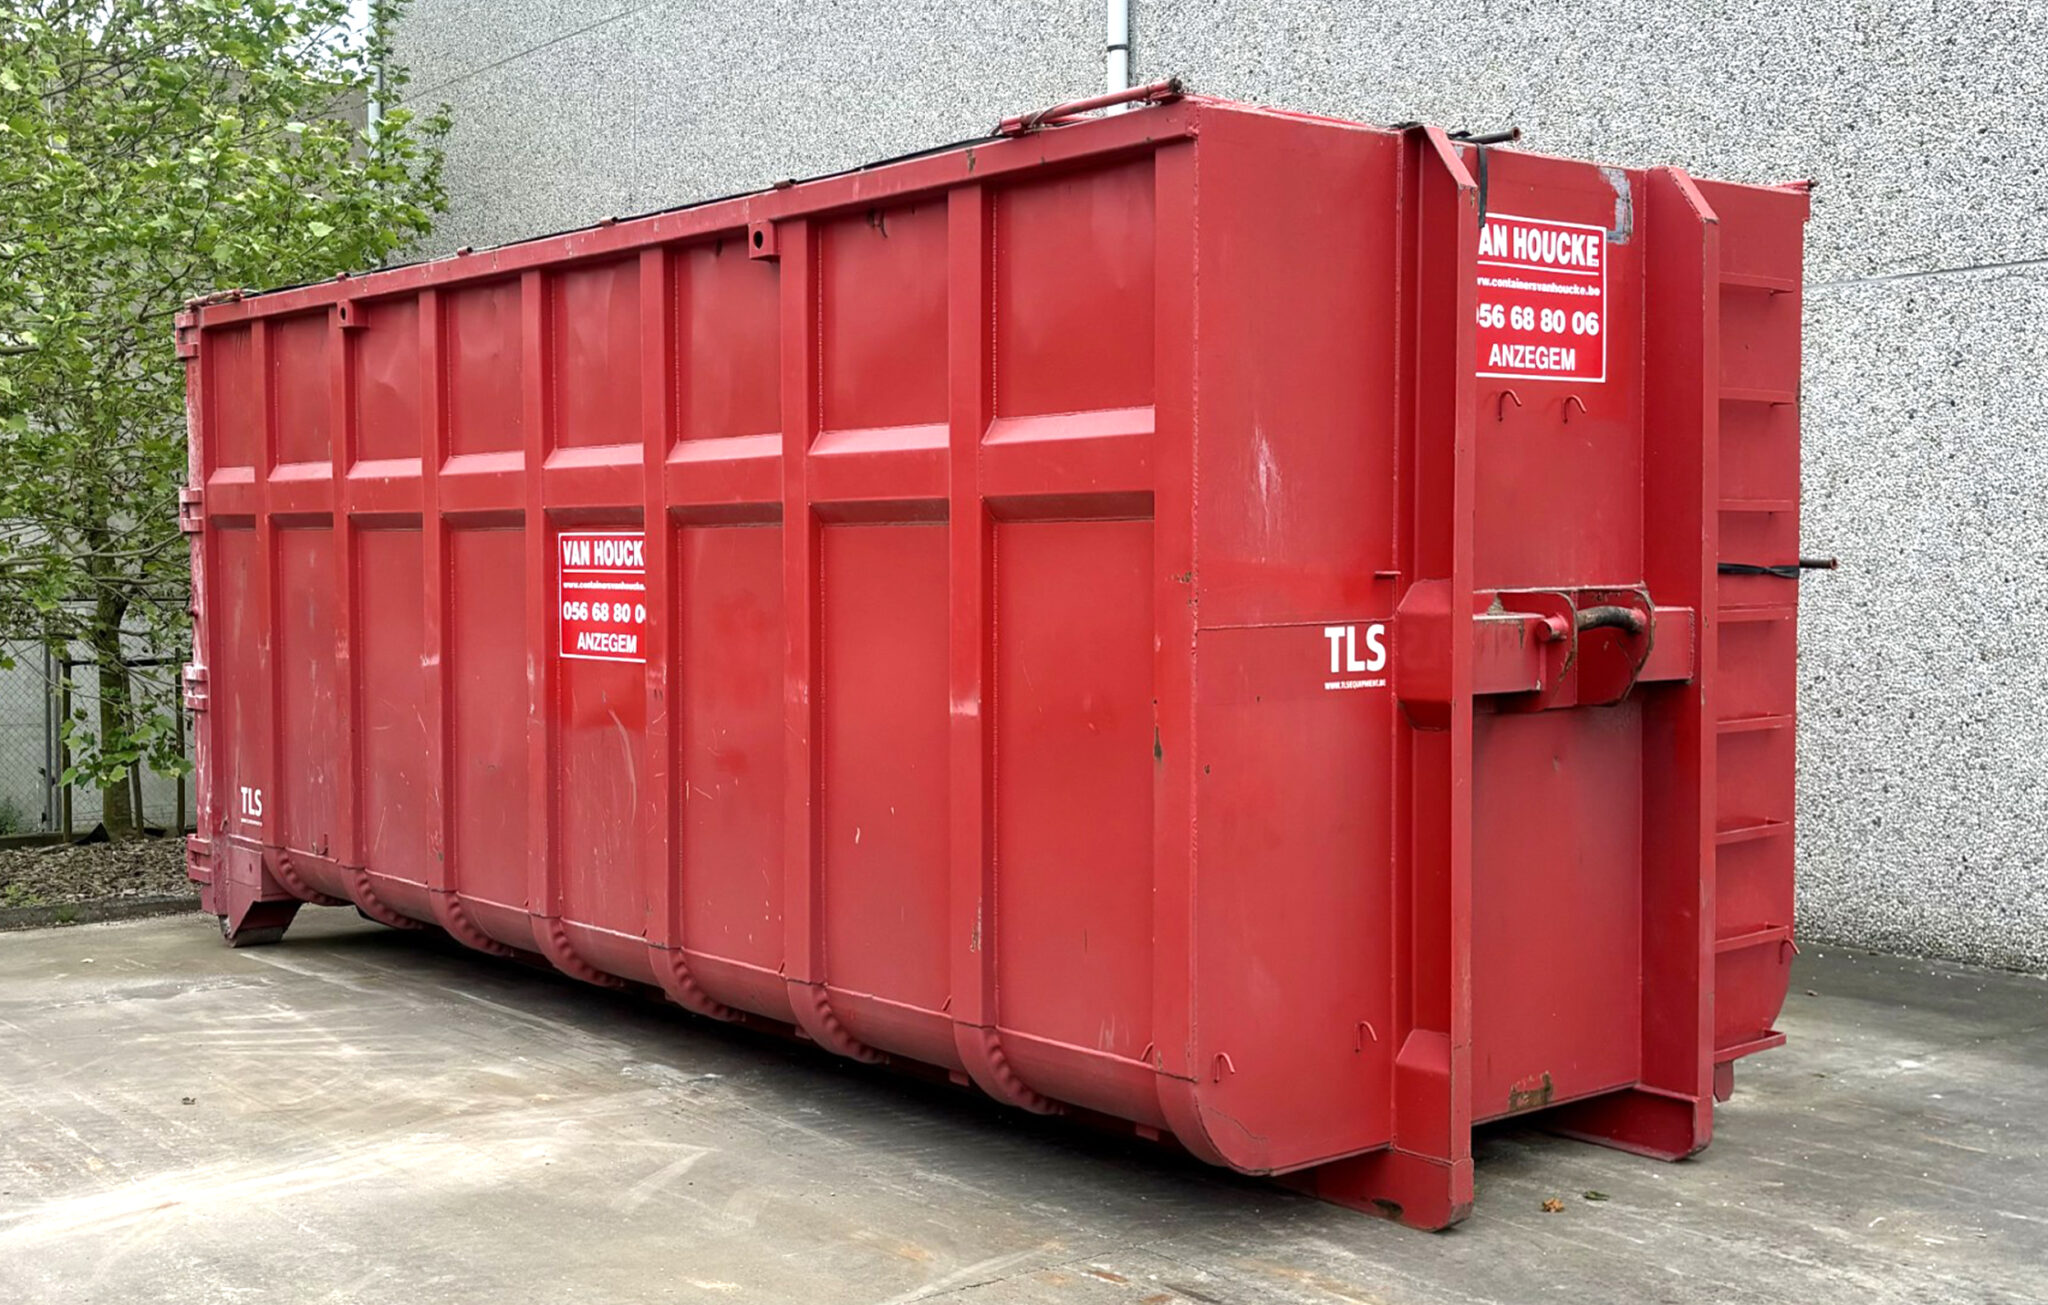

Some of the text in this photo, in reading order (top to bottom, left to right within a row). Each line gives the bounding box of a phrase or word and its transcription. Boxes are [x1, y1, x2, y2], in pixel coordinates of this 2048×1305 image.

[1478, 223, 1600, 267] AN HOUCKE
[1476, 304, 1599, 336] 56 68 80 06
[1488, 344, 1576, 371] ANZEGEM
[563, 540, 645, 566] VAN HOUCK
[563, 601, 646, 624] 056 68 80 0
[577, 632, 637, 653] ANZEGEM
[1324, 623, 1387, 673] TLS
[240, 786, 263, 817] TLS
